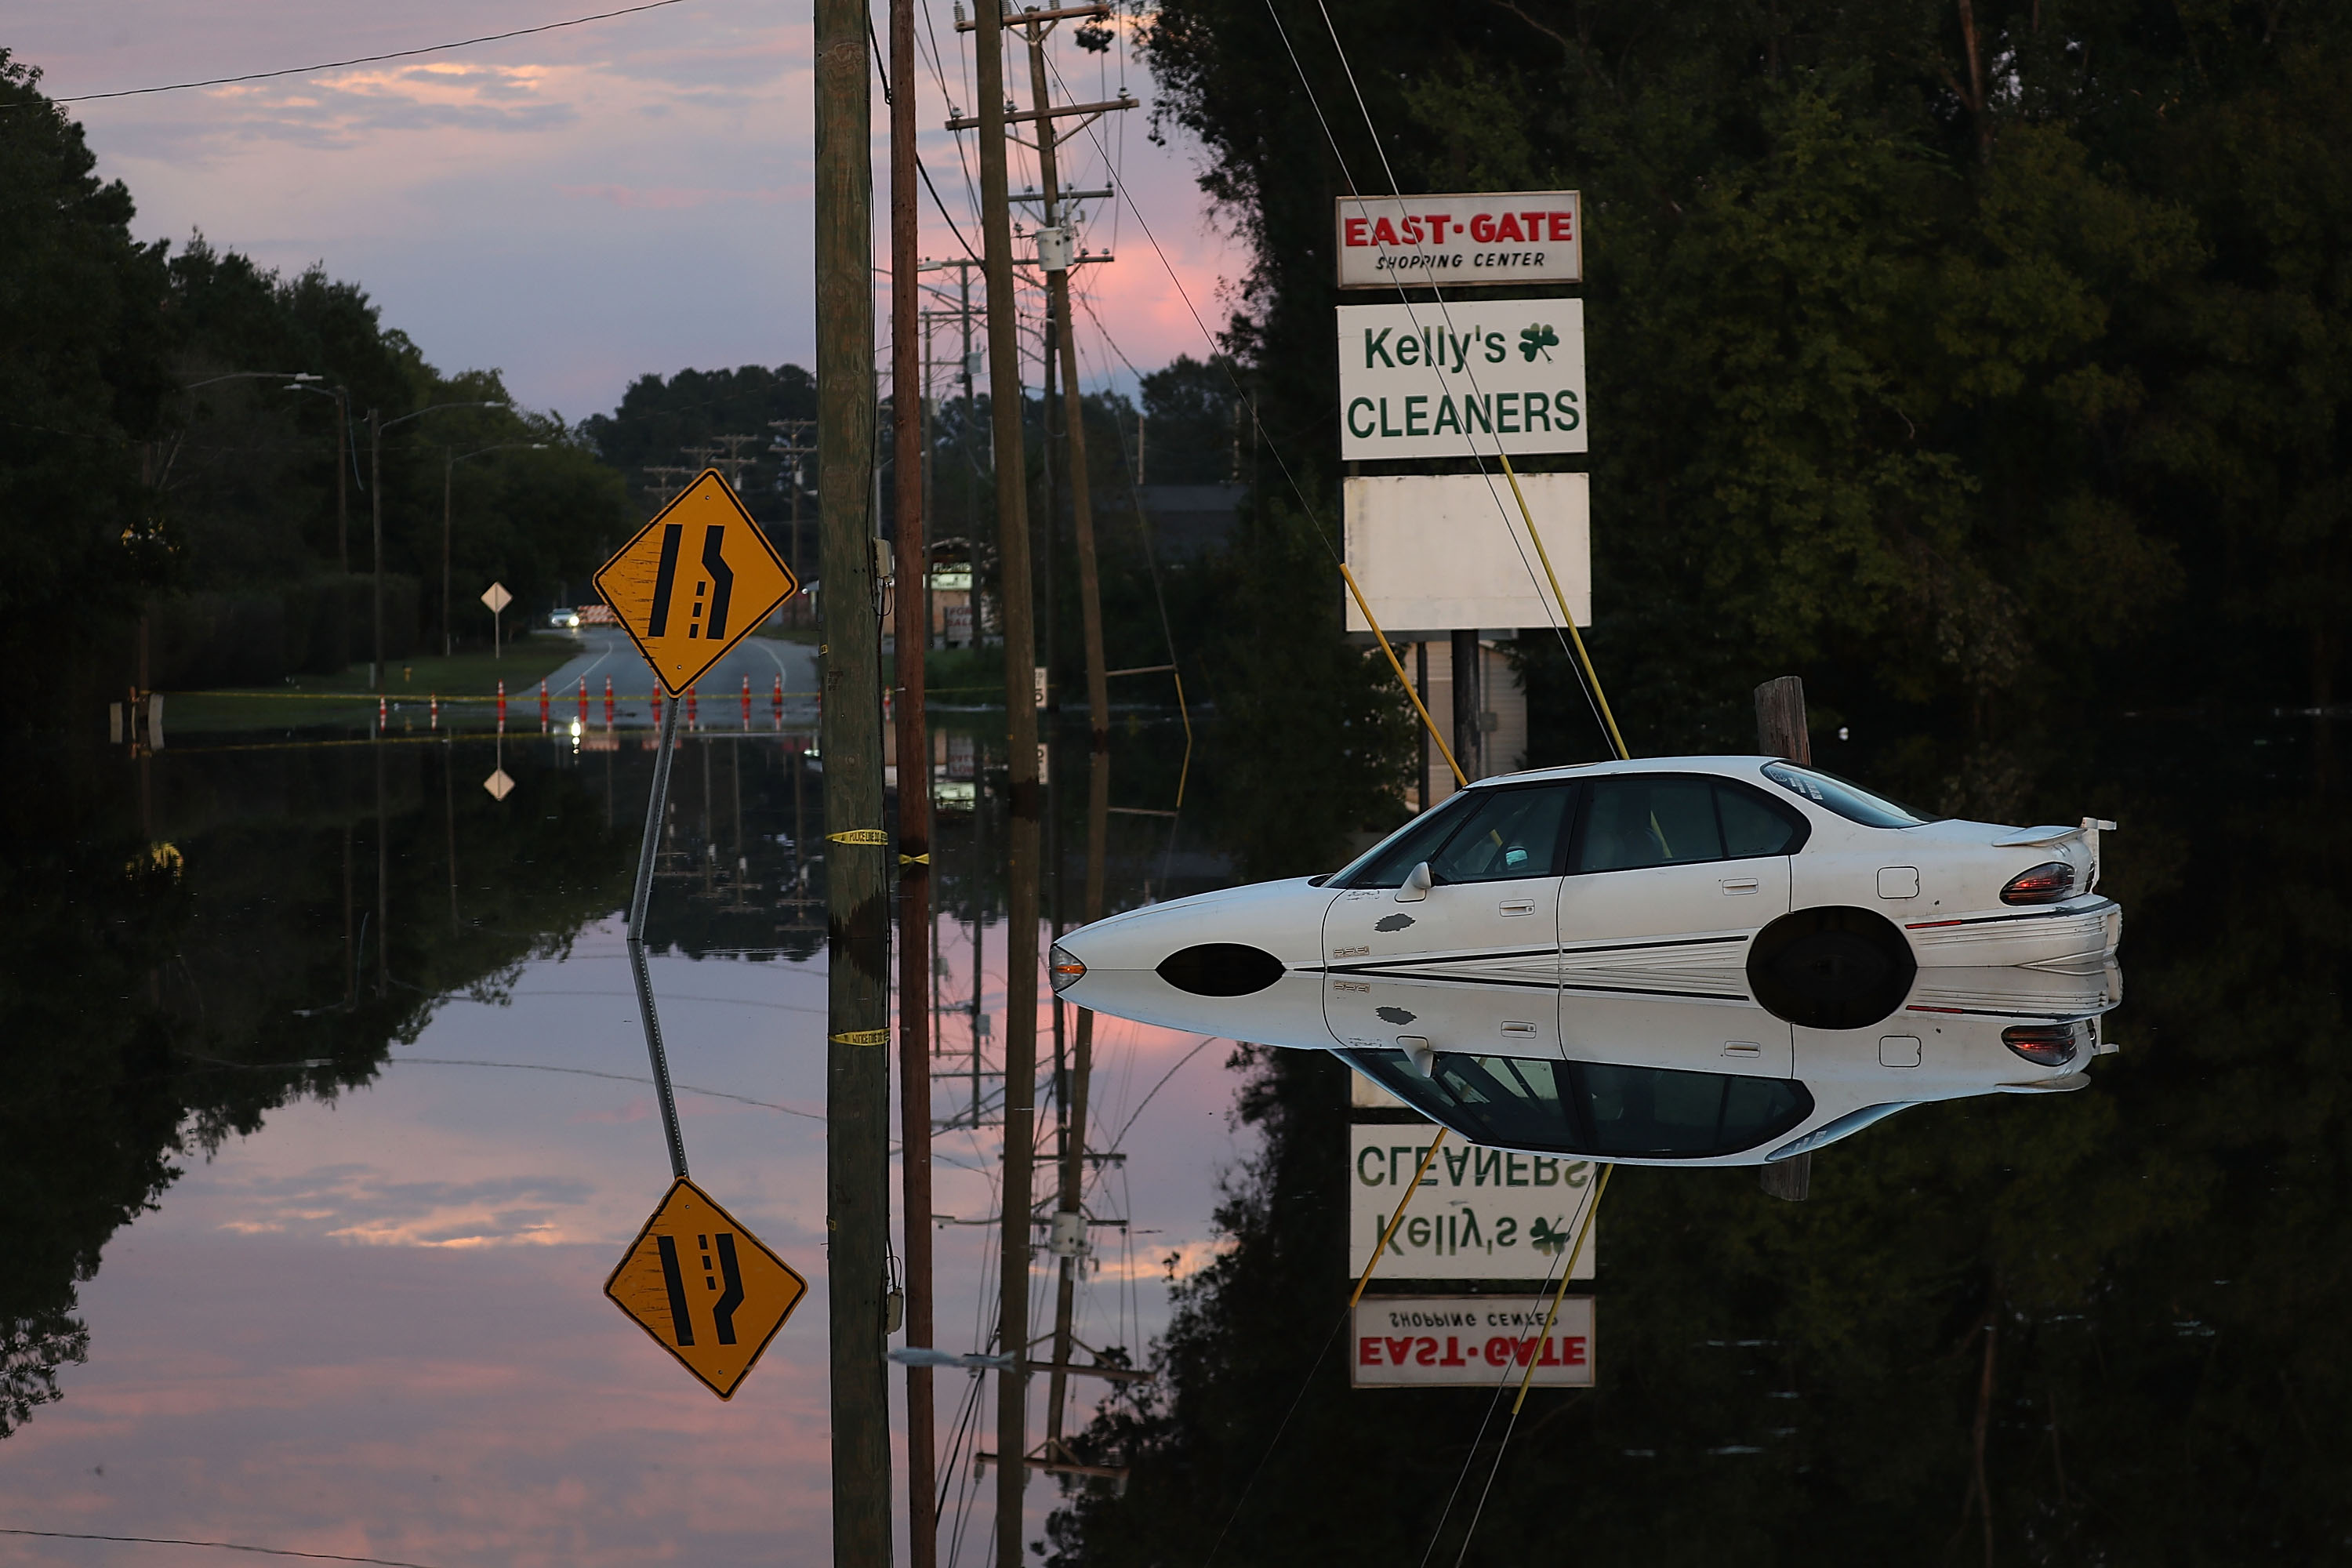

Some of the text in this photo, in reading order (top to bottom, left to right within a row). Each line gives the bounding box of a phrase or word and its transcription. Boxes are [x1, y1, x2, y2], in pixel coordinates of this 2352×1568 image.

[1376, 252, 1546, 270] SHOPPING CENTER
[1365, 325, 1506, 373] Kelly's
[1348, 390, 1580, 439] CLEANERS
